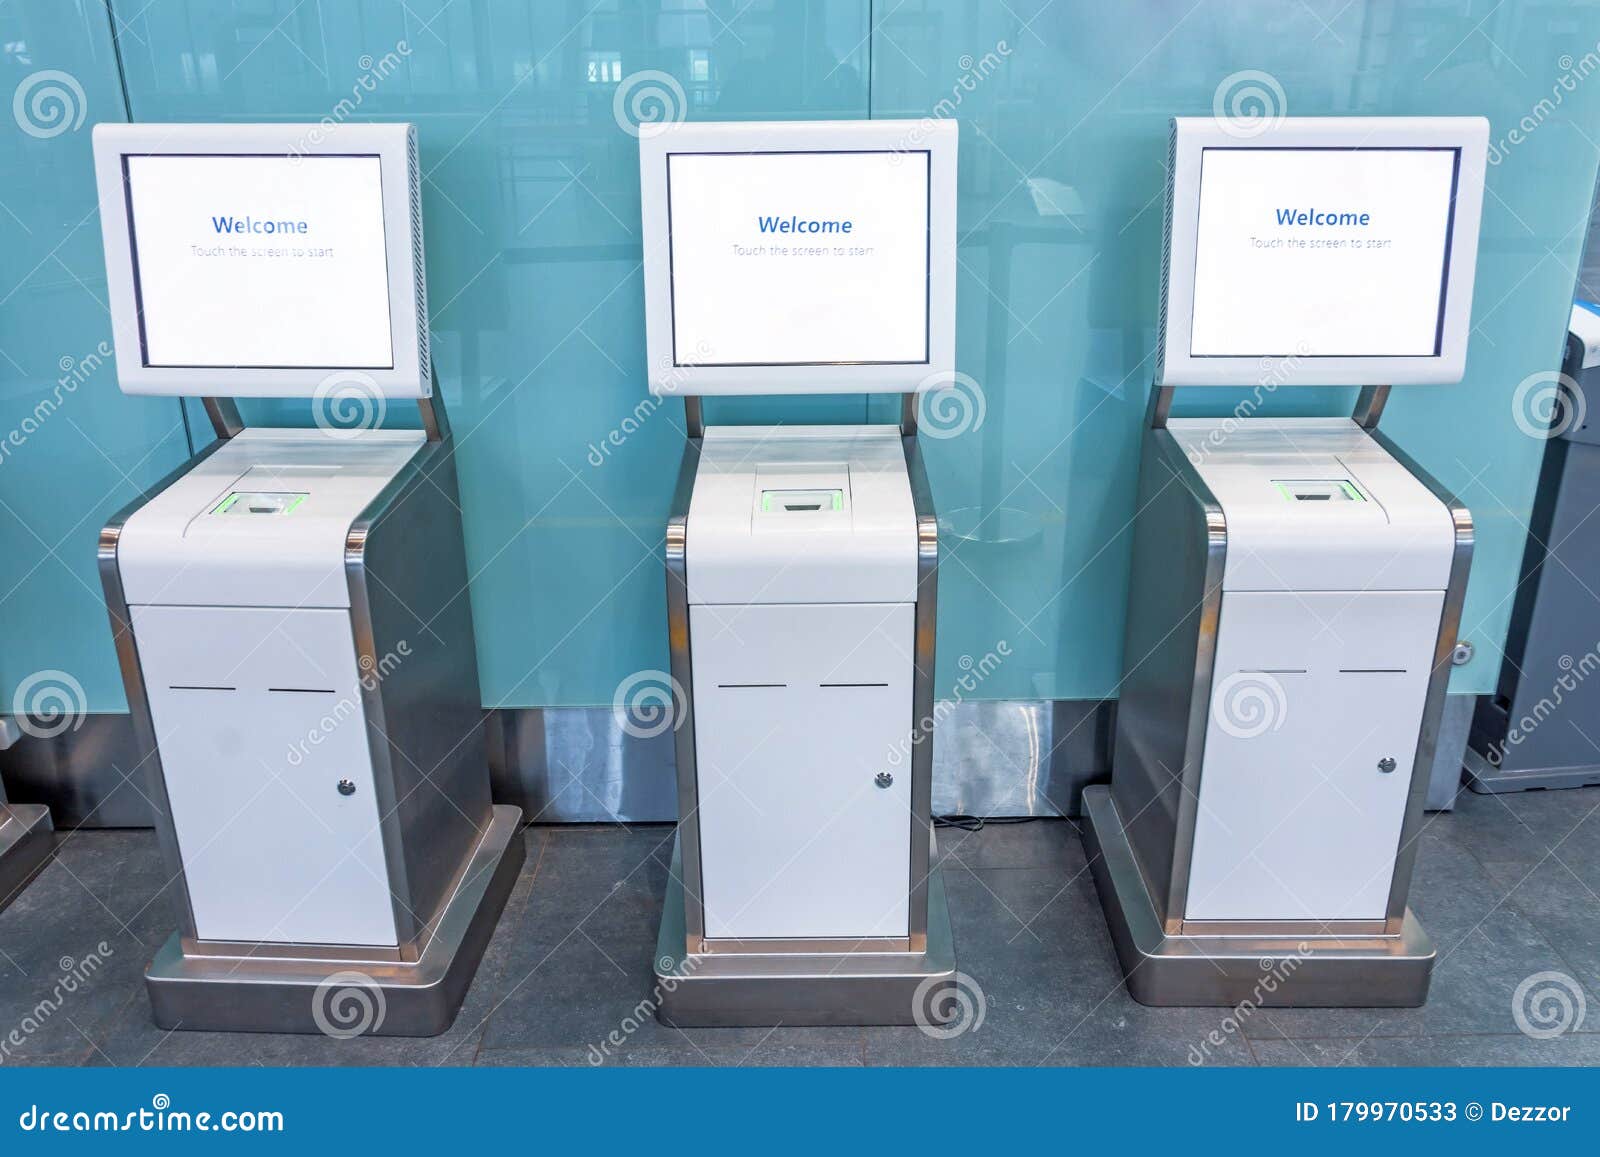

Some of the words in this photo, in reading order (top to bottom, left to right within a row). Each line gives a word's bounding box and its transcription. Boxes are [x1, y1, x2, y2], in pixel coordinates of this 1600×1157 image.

[758, 216, 853, 233] Welcome
[1276, 208, 1370, 226] Welcome
[212, 216, 308, 234] Welcome
[732, 244, 767, 256] Touch
[769, 244, 789, 256] the
[792, 247, 830, 256] screen
[833, 247, 846, 256] to
[1250, 236, 1284, 249] Touch
[1287, 236, 1307, 249] the
[1310, 239, 1347, 249] screen
[1350, 238, 1363, 249] to
[1366, 238, 1392, 249] start
[190, 245, 225, 257] Touch
[228, 245, 248, 257] the
[251, 247, 289, 257] screen
[292, 247, 305, 257] to
[308, 247, 335, 258] start
